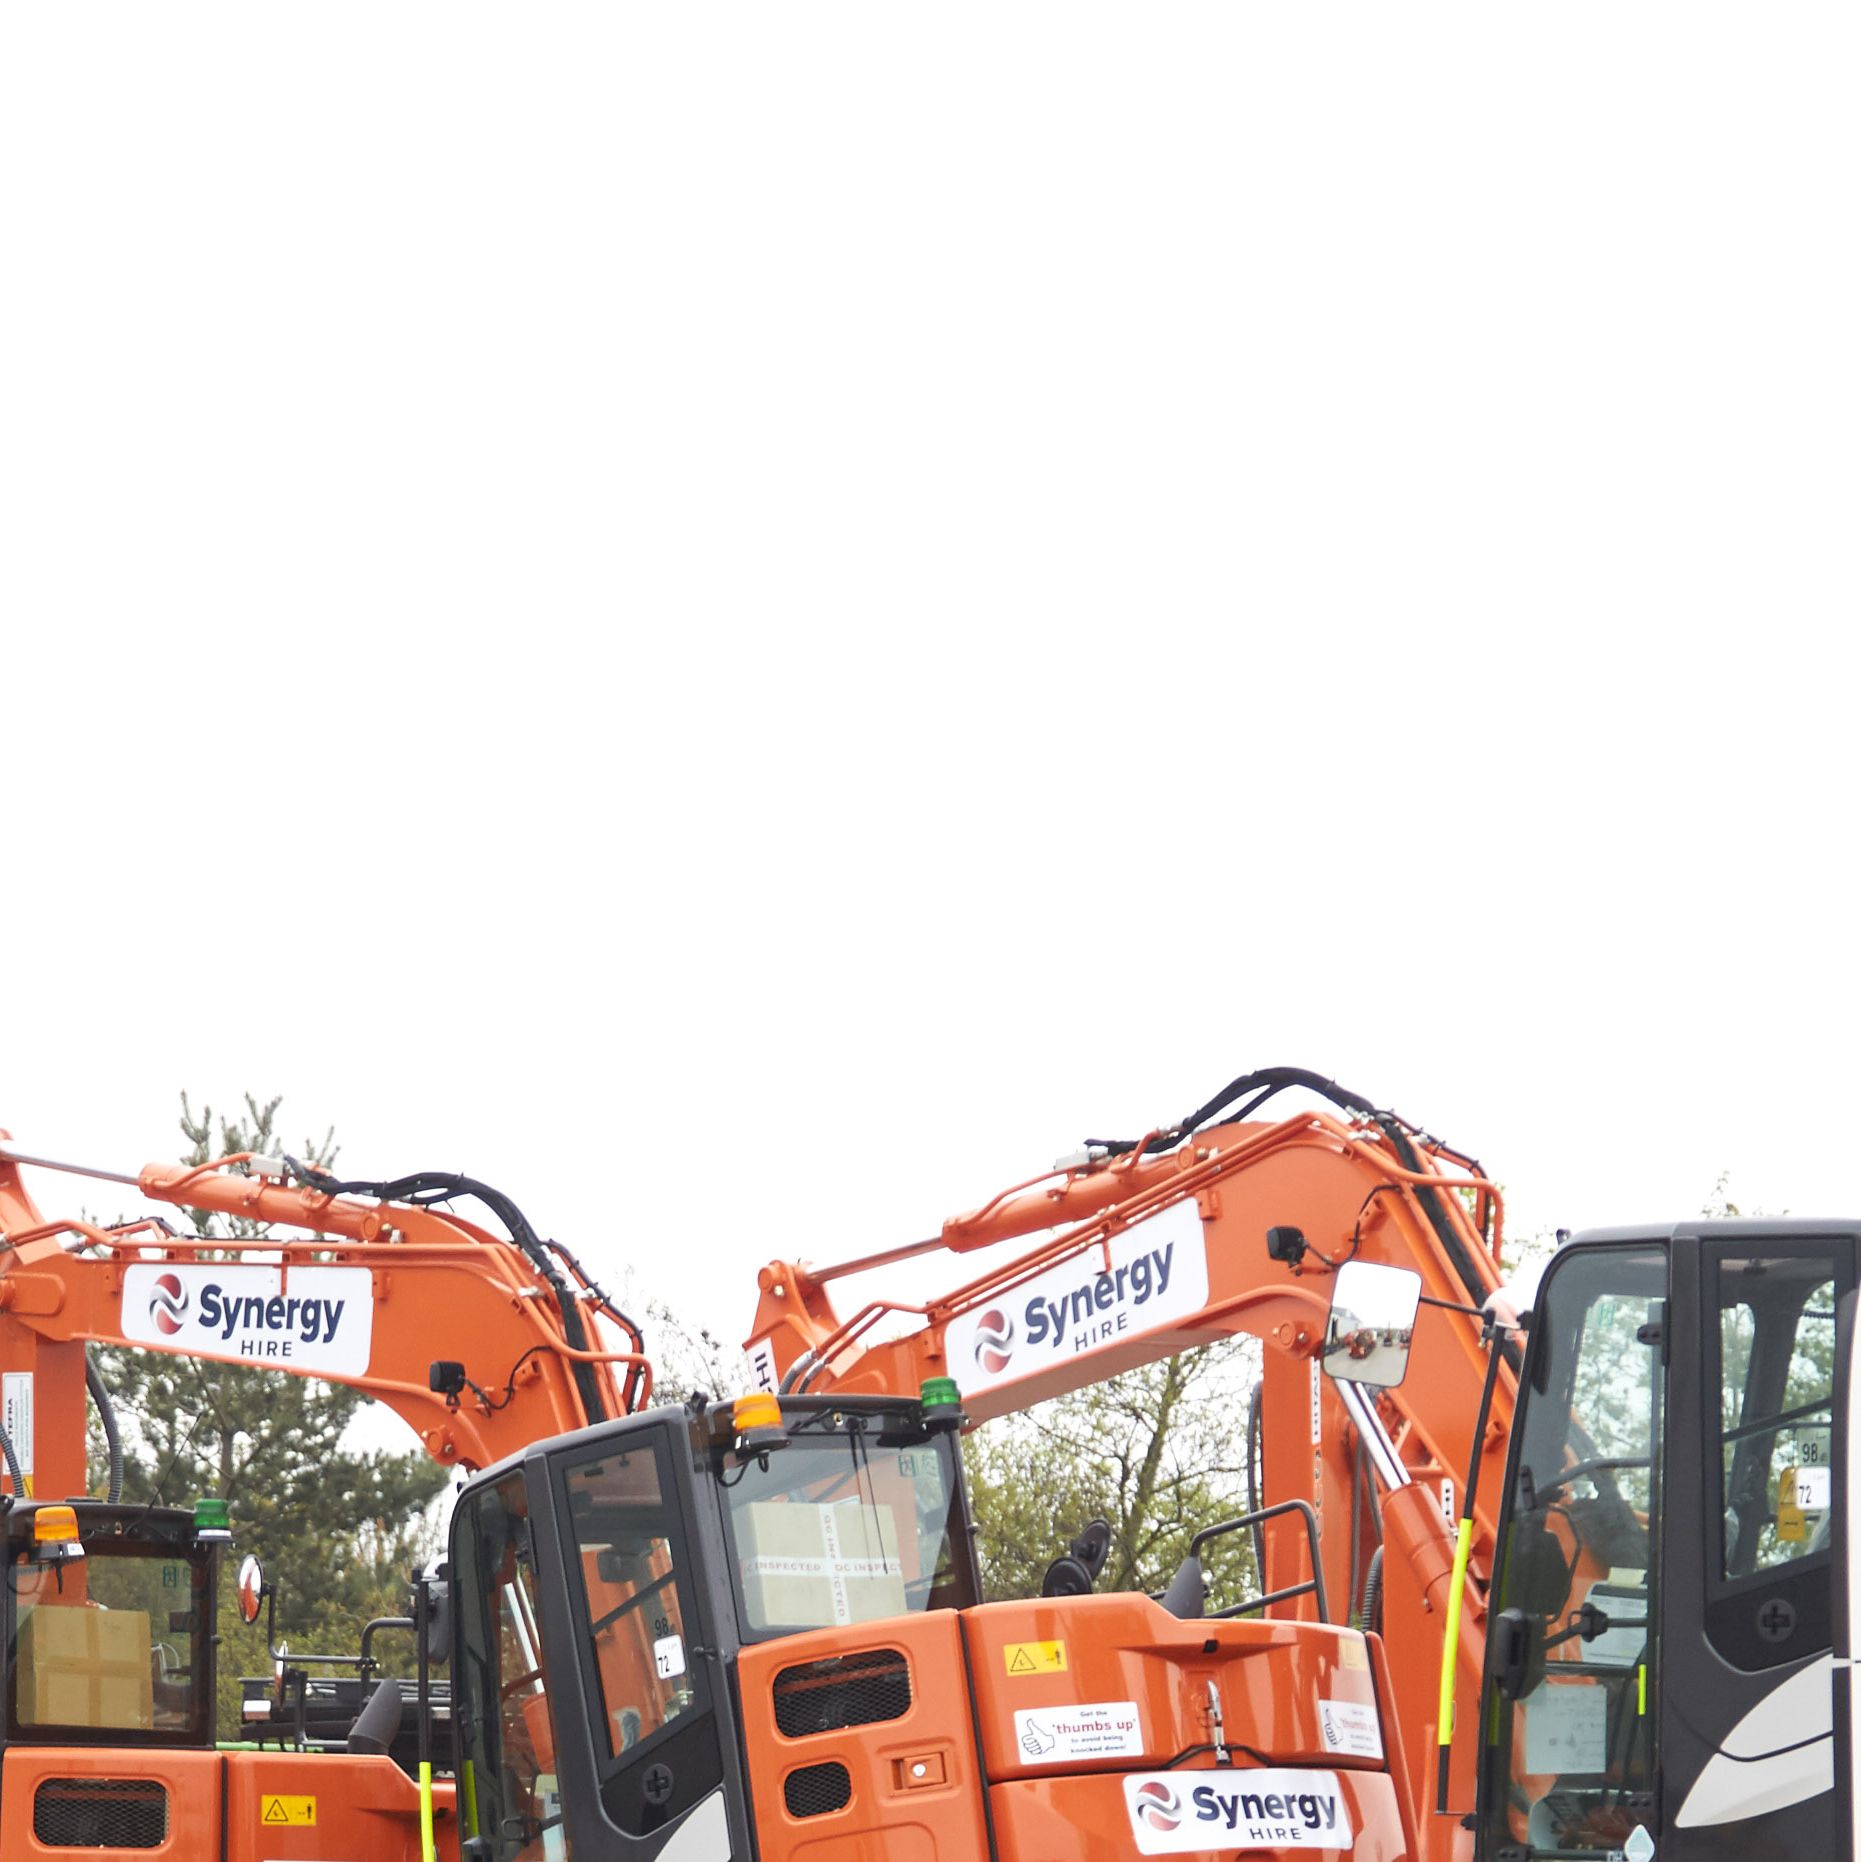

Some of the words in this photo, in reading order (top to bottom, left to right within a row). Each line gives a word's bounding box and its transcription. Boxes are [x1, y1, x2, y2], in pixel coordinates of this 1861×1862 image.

[1025, 1241, 1174, 1348] Synergy
[198, 1283, 345, 1344] Synergy
[1075, 1312, 1128, 1351] HIRE
[241, 1340, 292, 1357] HIRE
[1802, 1443, 1818, 1462] 98
[1799, 1485, 1812, 1504] 72
[658, 1655, 670, 1674] 72
[1192, 1786, 1335, 1830] Synergy
[1249, 1828, 1302, 1840] HIRE
